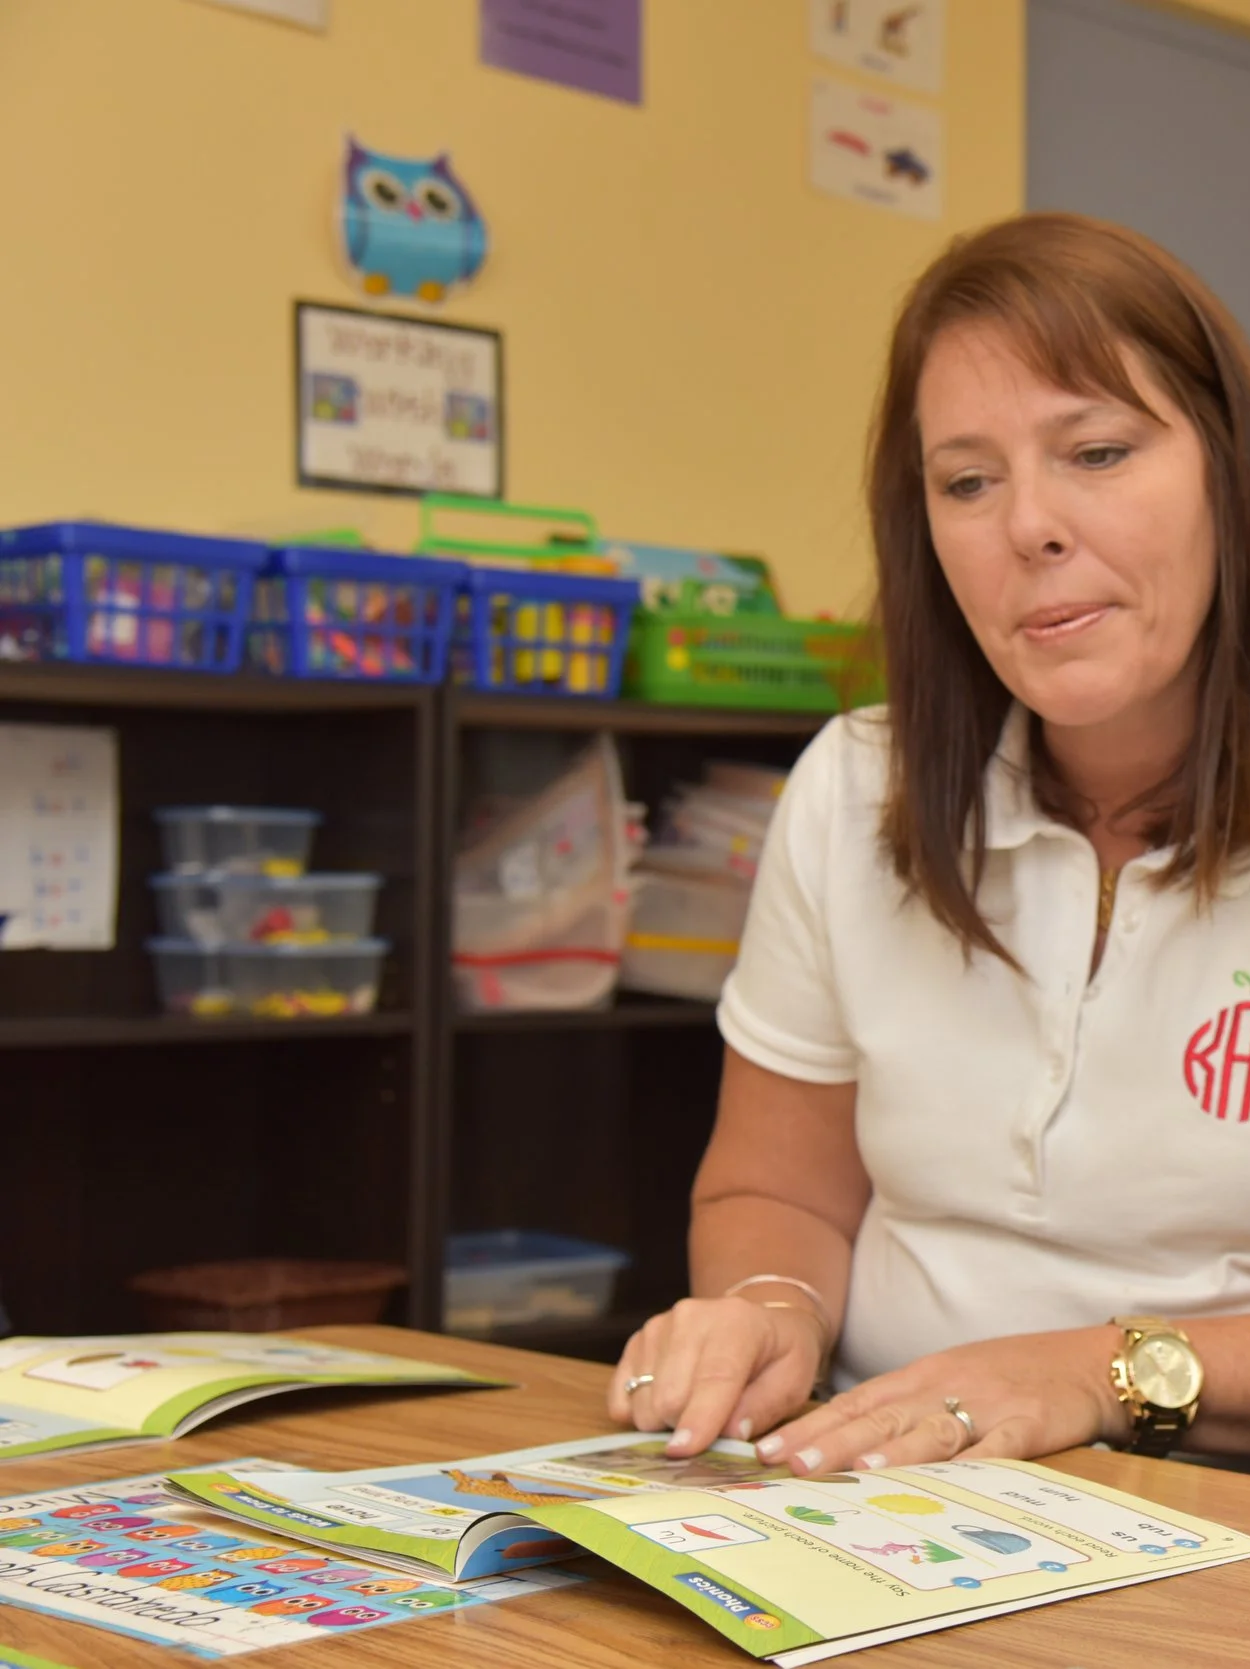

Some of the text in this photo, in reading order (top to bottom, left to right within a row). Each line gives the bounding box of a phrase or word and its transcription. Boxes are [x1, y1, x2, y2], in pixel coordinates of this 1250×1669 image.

[1000, 1490, 1046, 1507] mud
[1038, 1486, 1082, 1502] hum
[325, 1503, 381, 1520] have
[660, 1530, 687, 1545] Uu
[1052, 1527, 1085, 1545] each
[1111, 1530, 1139, 1542] us
[1137, 1523, 1174, 1537] rub
[743, 1511, 911, 1598] Say the name of each picture.
[1084, 1540, 1119, 1559] Read
[688, 1575, 751, 1613] Phonics
